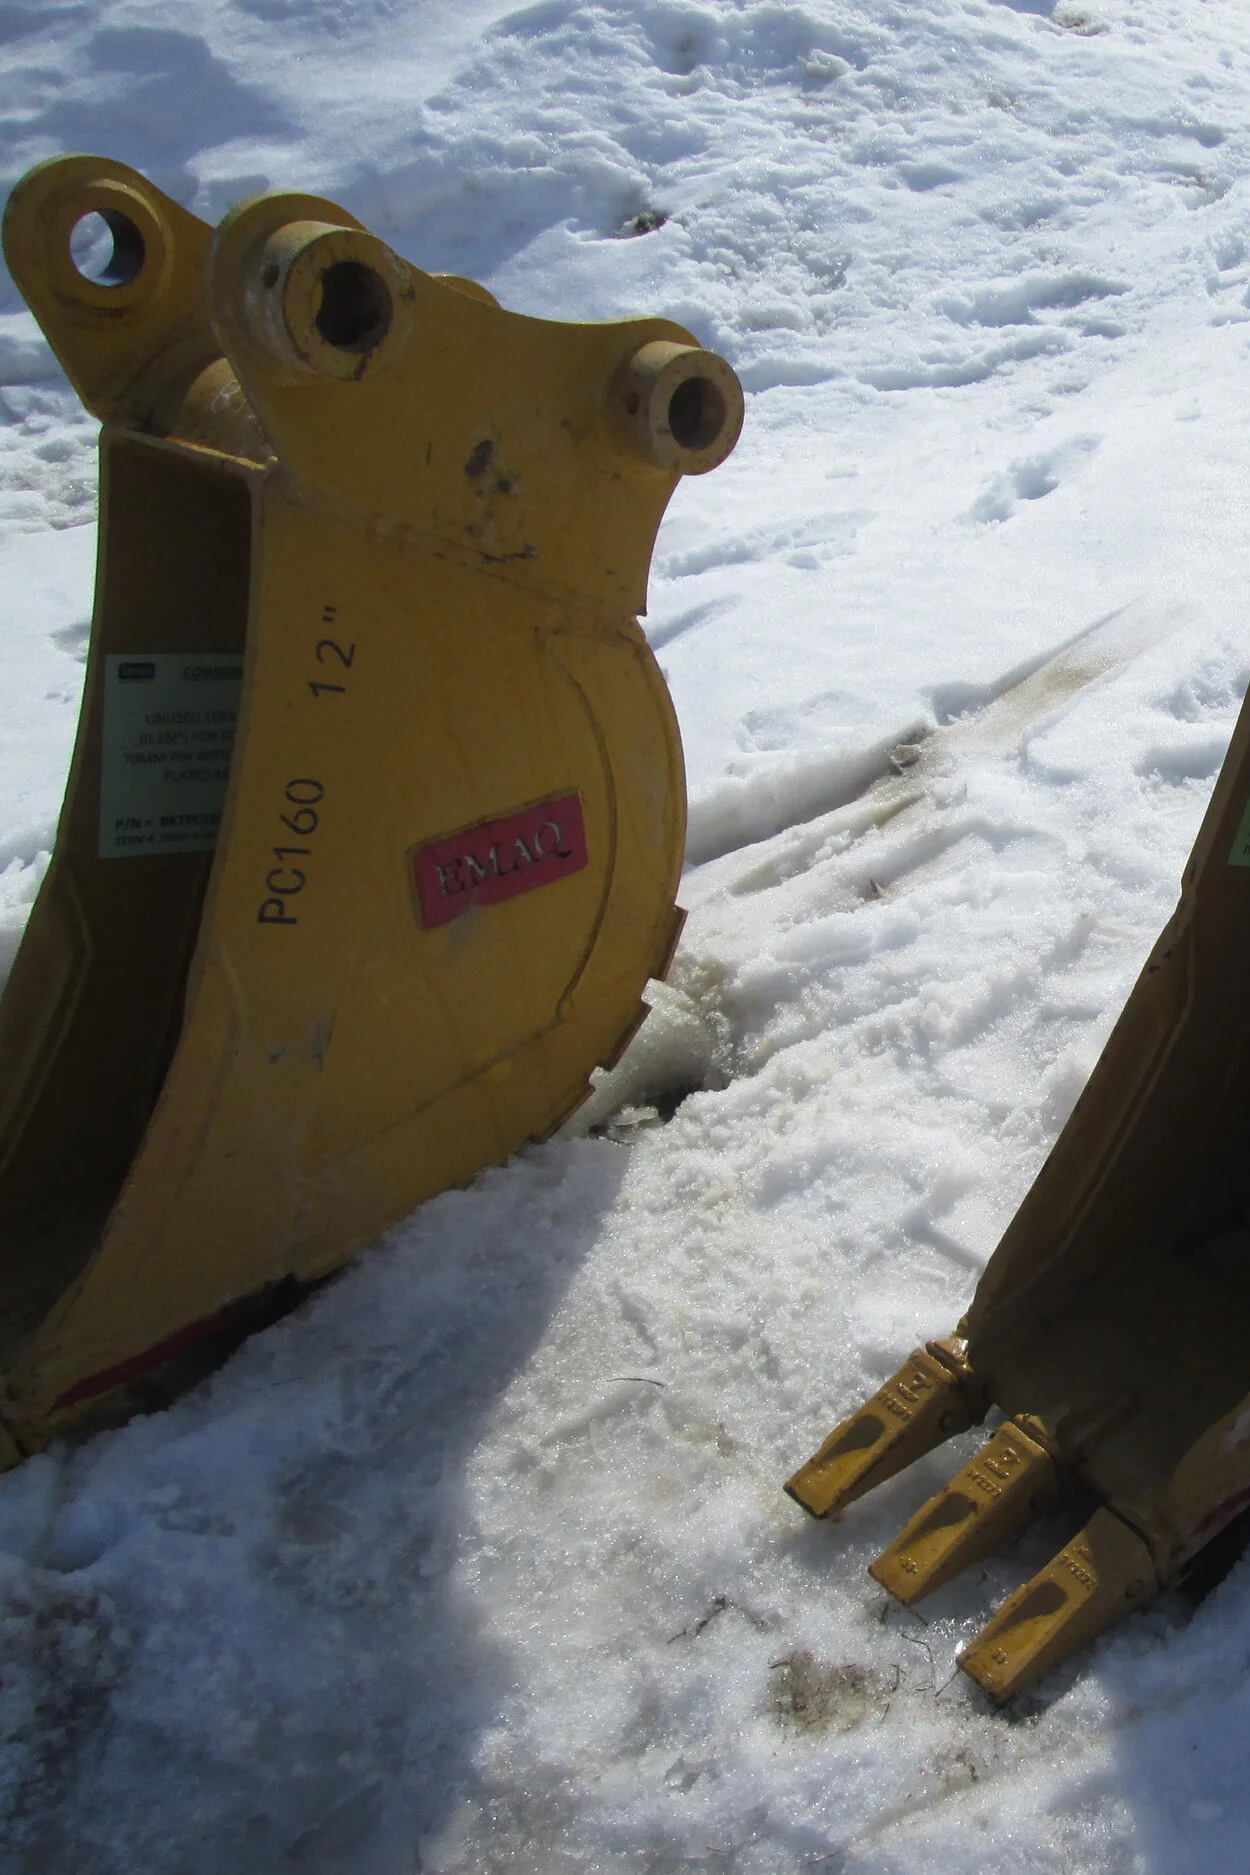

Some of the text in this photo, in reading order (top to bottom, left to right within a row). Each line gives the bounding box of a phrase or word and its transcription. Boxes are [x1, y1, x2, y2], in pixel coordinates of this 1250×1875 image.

[257, 604, 356, 925] PC160 12"
[436, 820, 572, 899] EMAQ
